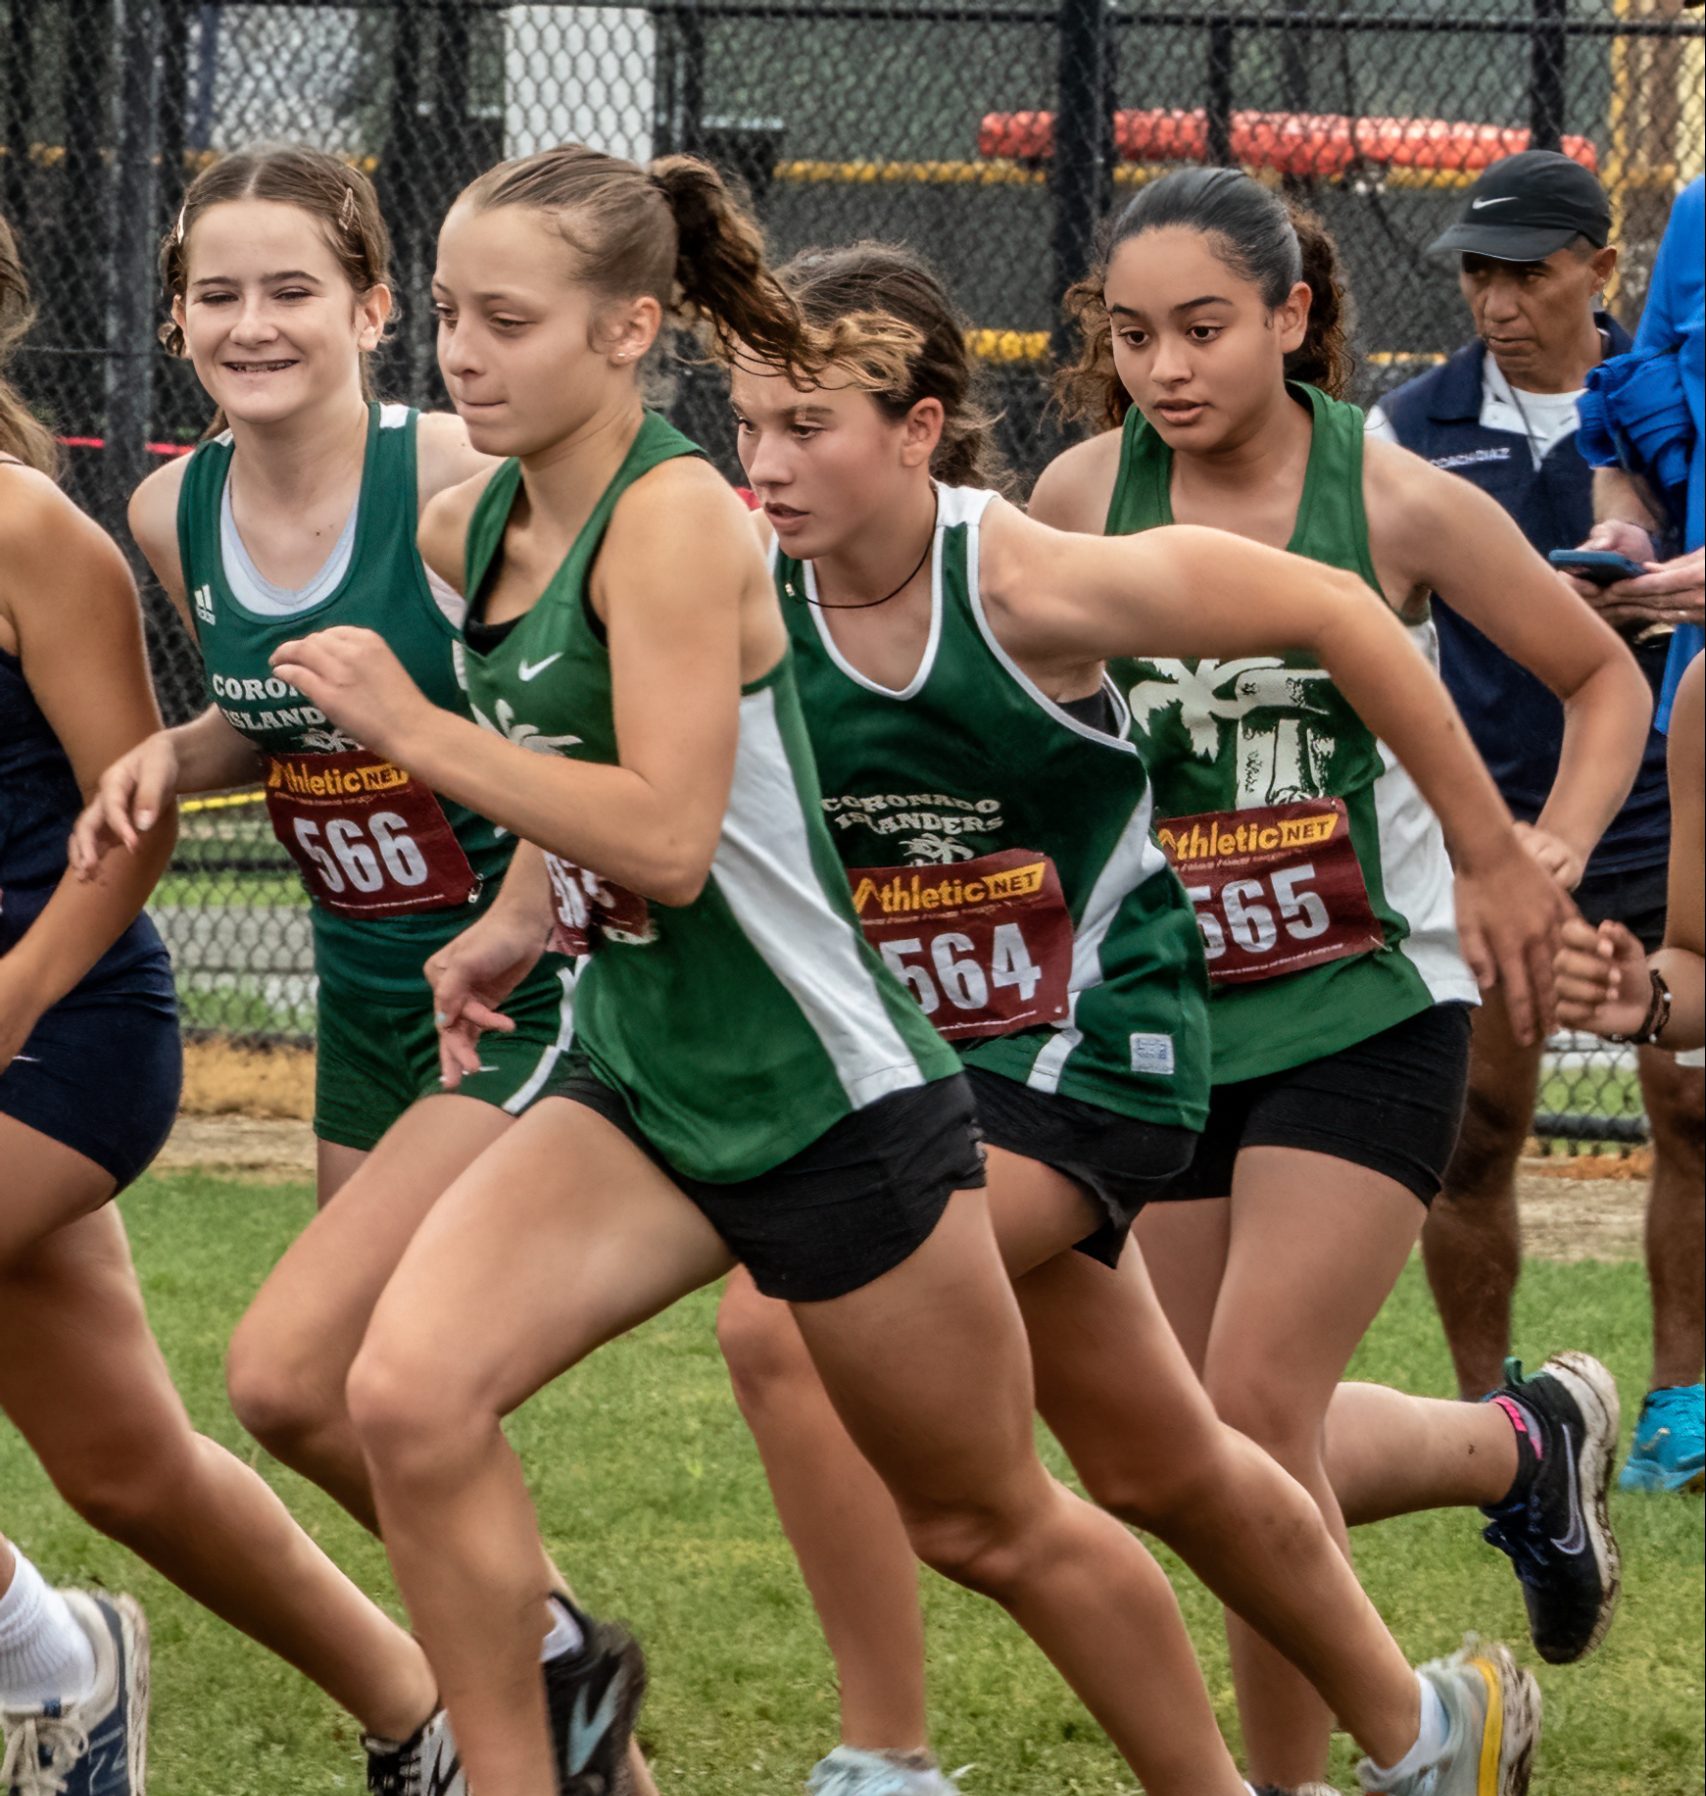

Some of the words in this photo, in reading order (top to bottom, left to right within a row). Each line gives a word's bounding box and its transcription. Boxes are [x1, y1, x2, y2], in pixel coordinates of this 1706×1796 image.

[293, 811, 428, 893] 566
[1186, 864, 1330, 959] 565
[879, 922, 1042, 1015] 564
